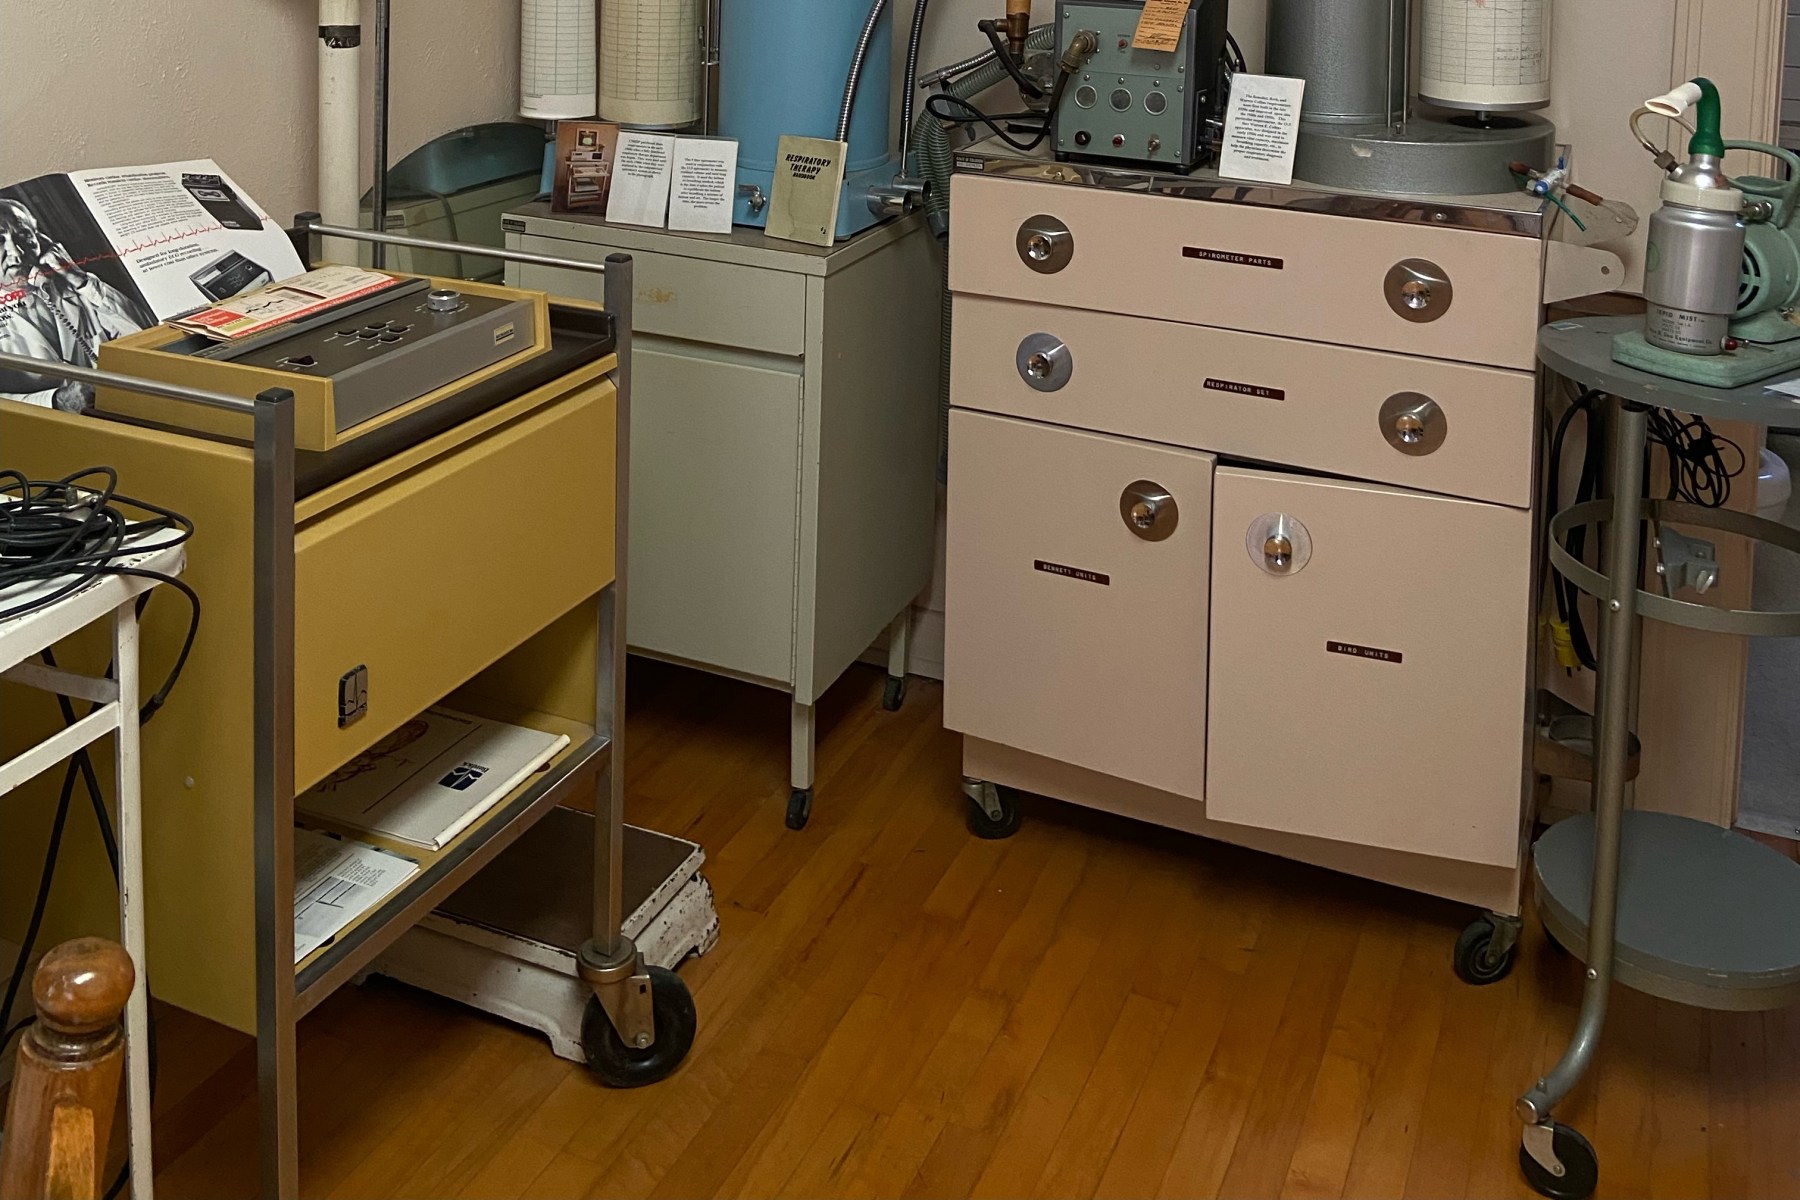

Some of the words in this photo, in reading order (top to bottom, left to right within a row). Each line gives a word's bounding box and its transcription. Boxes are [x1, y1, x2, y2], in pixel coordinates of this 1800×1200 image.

[785, 154, 831, 167] RESPIRATORY
[790, 163, 821, 175] THERAPY
[1199, 252, 1244, 262] SPIROMETER
[1248, 258, 1272, 266] PARTS
[1656, 308, 1673, 318] TEPID
[1679, 314, 1697, 322] MIST
[1206, 380, 1252, 392] RESPIRATOR
[1256, 388, 1270, 396] SET
[1043, 564, 1071, 575] BENNETT
[1076, 571, 1096, 580] UNITS
[1338, 645, 1358, 654] BIRD
[1364, 650, 1388, 659] UNITS
